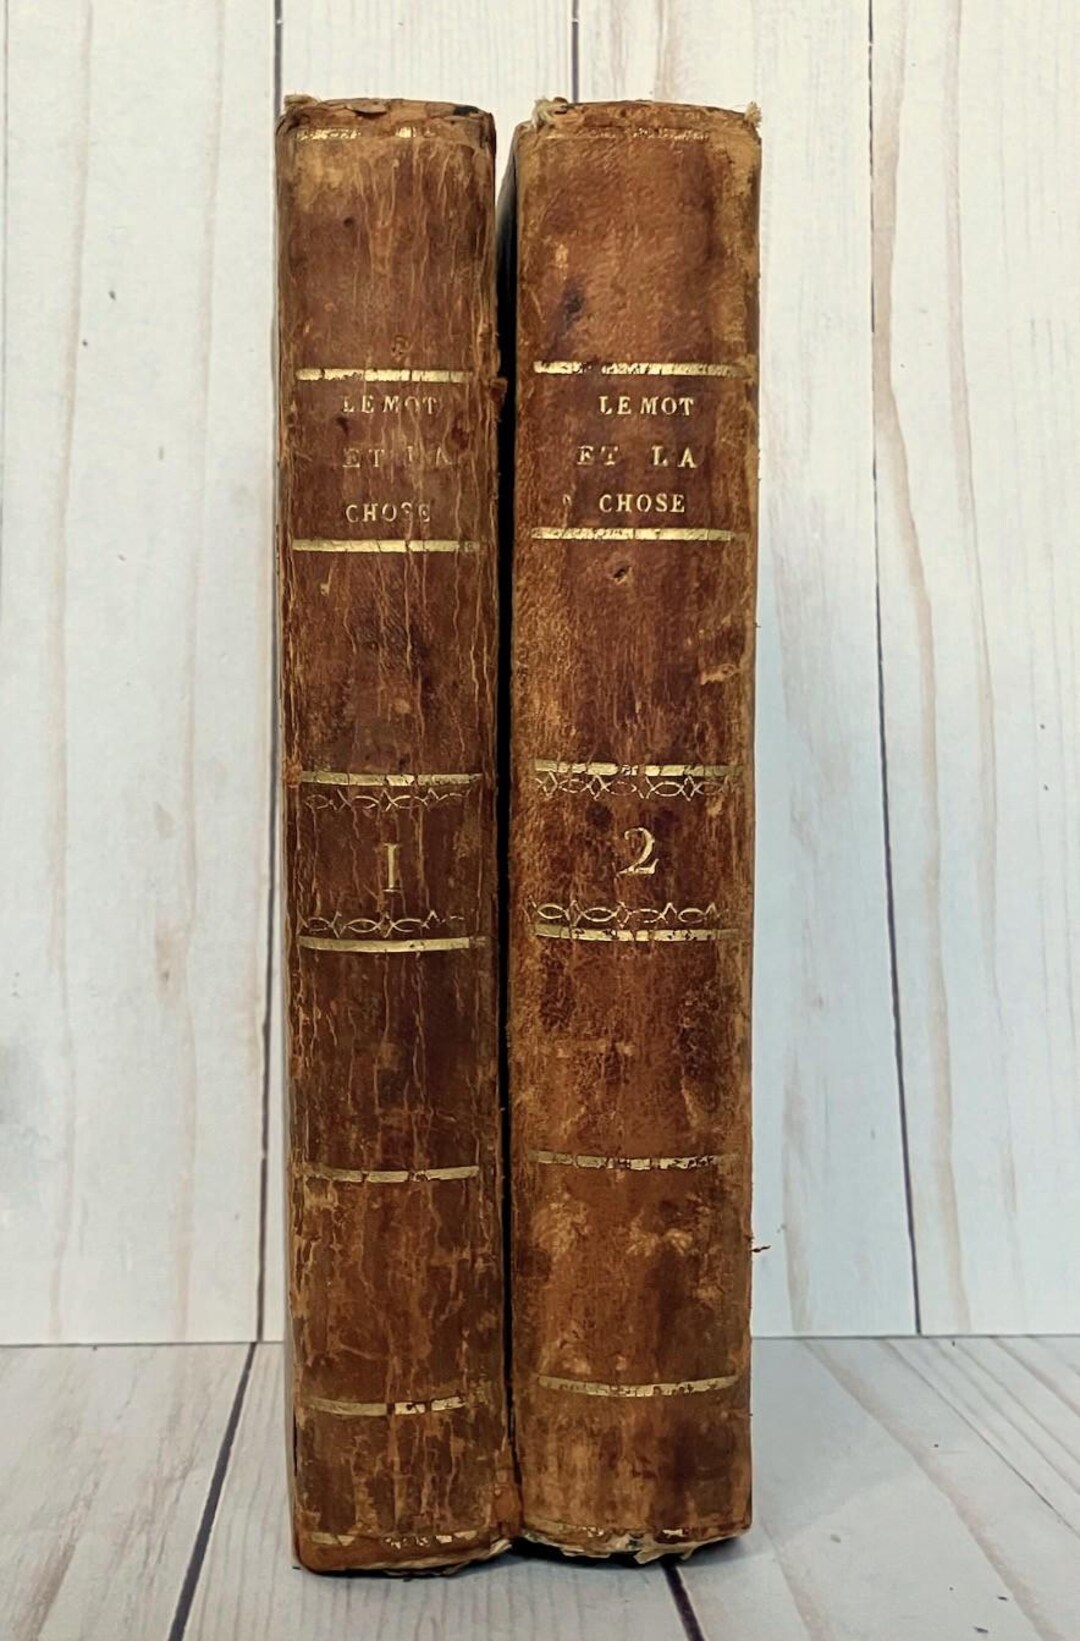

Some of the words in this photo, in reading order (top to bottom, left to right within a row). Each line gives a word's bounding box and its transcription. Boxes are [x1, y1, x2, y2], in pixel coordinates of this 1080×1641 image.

[651, 445, 698, 469] LA
[598, 493, 686, 513] CHOSE
[618, 827, 657, 875] 2
